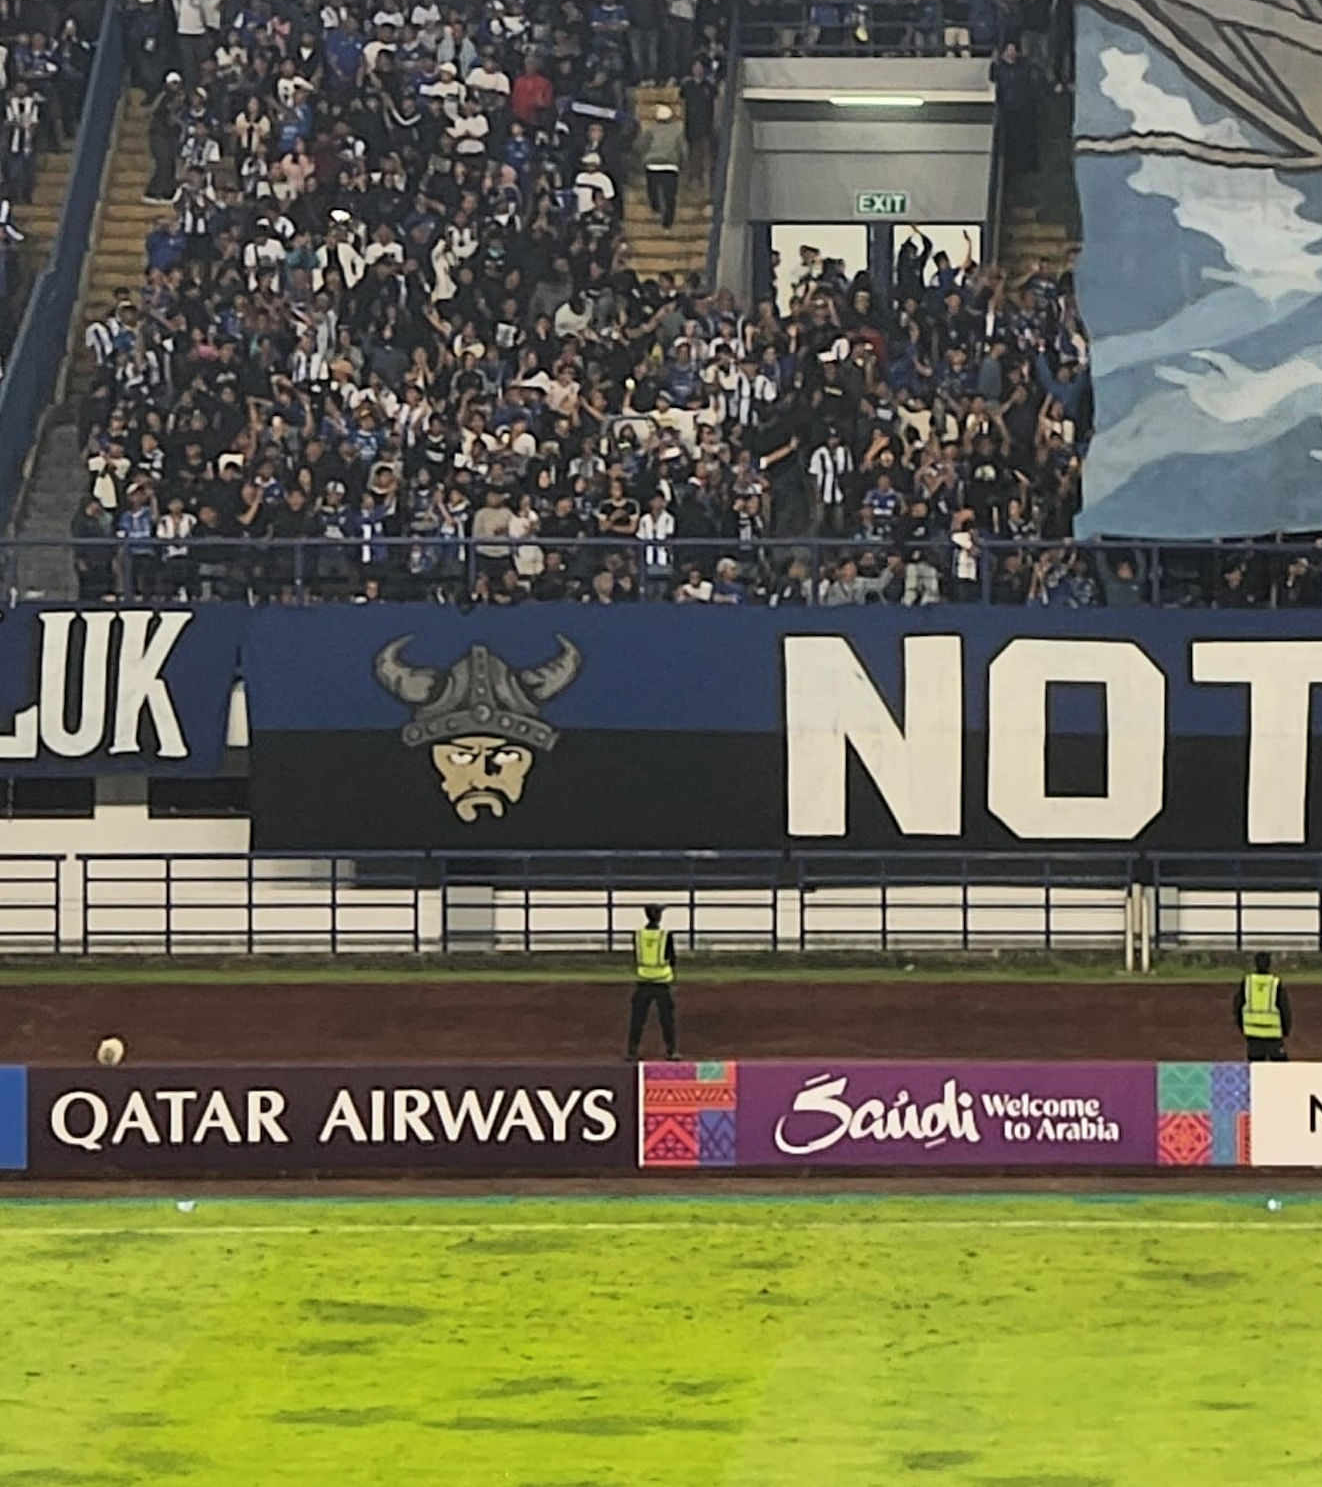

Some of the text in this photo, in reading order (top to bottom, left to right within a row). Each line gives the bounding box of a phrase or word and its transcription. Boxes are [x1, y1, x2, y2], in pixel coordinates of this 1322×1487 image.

[859, 195, 905, 212] EXIT
[981, 1093, 1100, 1118] Welcome
[51, 1089, 617, 1151] QATAR AIRWAYS
[1004, 1115, 1120, 1142] to Arabia
